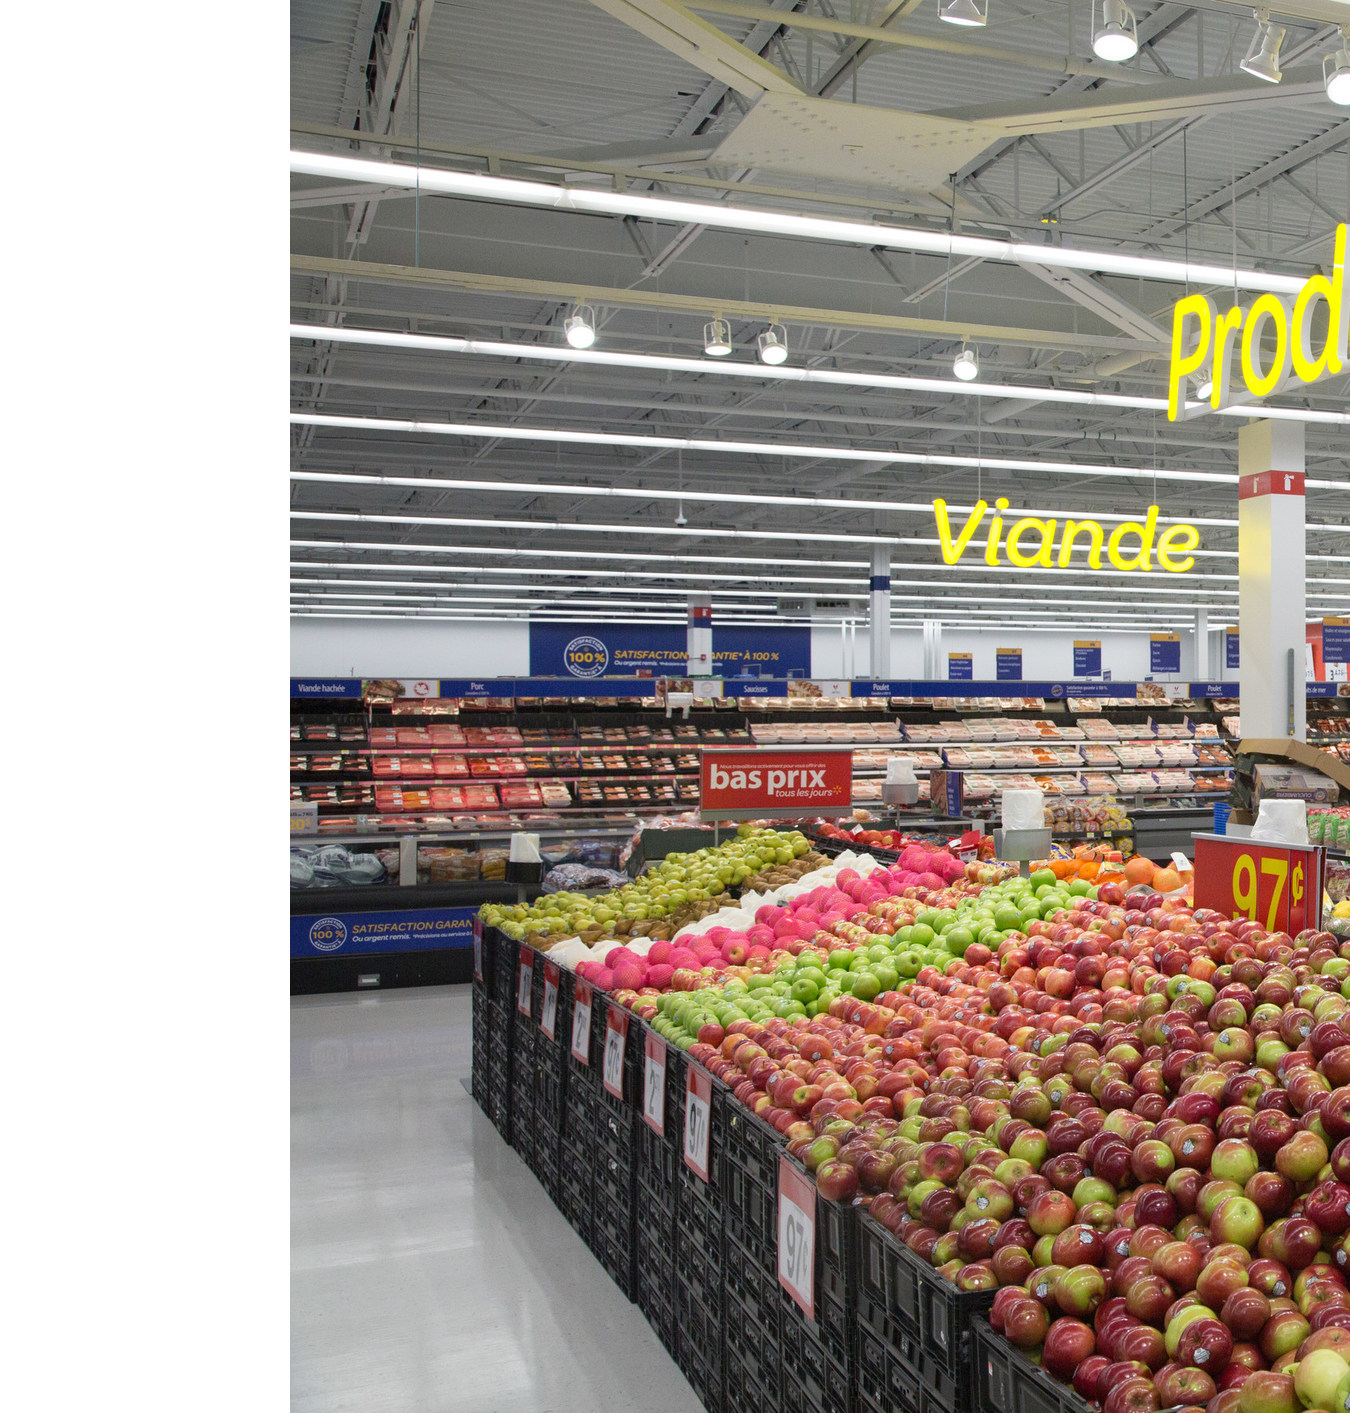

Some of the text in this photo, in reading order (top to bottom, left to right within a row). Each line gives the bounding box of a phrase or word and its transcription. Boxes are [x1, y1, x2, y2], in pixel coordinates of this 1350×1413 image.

[932, 497, 1200, 573] Viande
[569, 653, 605, 663] 100 %
[614, 650, 687, 660] SATISFACTION
[712, 651, 743, 660] ANTIE
[752, 652, 770, 660] 100
[770, 652, 779, 660] %
[298, 683, 346, 693] Viande hachée
[471, 682, 484, 691] Porc
[744, 684, 768, 694] Saucisses
[872, 683, 890, 692] Poulet
[1207, 684, 1222, 692] Poulet
[710, 763, 826, 795] bas prix
[775, 788, 833, 798] tous les jours
[1232, 854, 1304, 932] 97¢
[352, 920, 473, 934] SATISFACTION GARAN
[312, 930, 344, 939] 100 %
[364, 935, 389, 943] argent
[786, 1214, 808, 1286] 97¢
